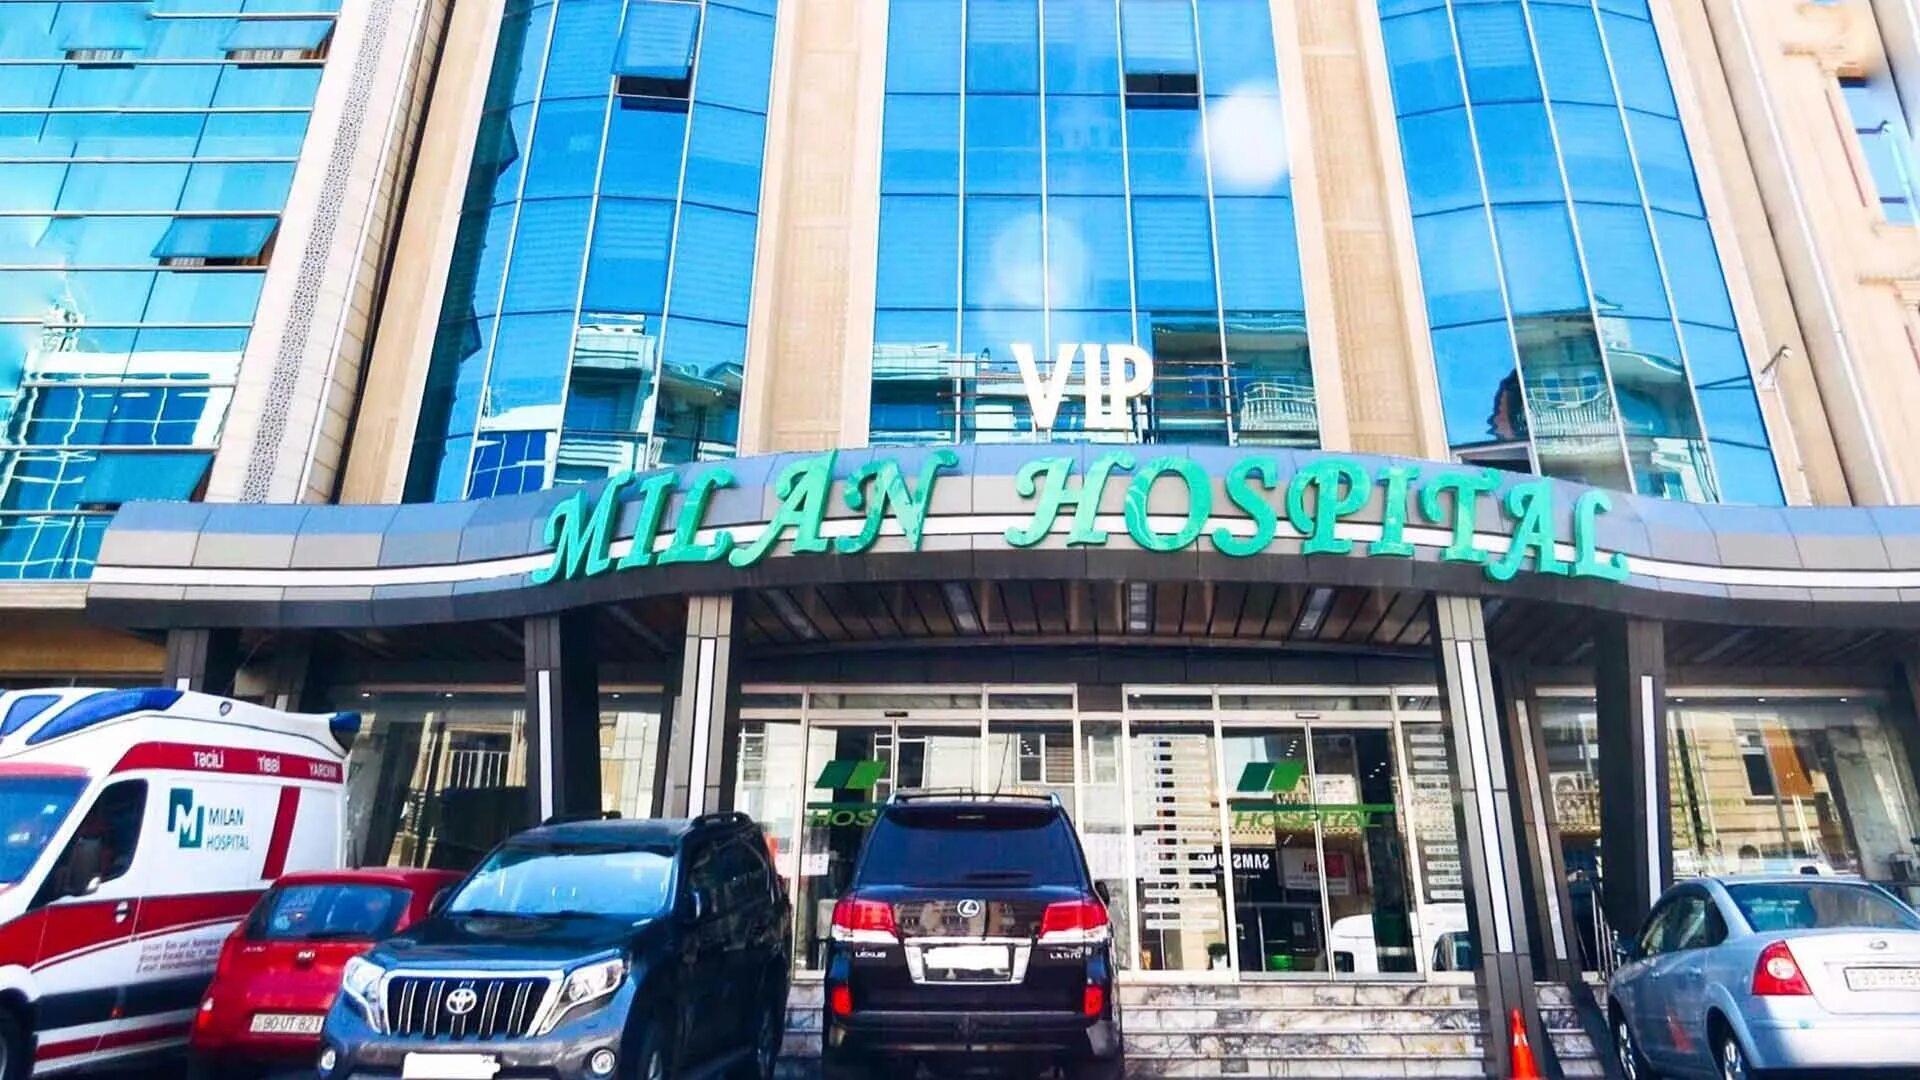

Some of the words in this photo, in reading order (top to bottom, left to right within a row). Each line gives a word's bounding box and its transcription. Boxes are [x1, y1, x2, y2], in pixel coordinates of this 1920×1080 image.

[1010, 343, 1153, 429] VIP
[530, 448, 959, 584] MILAN
[1004, 450, 1629, 583] HOSPITAL
[206, 834, 250, 851] HOSPITAL
[208, 807, 244, 826] MILAN
